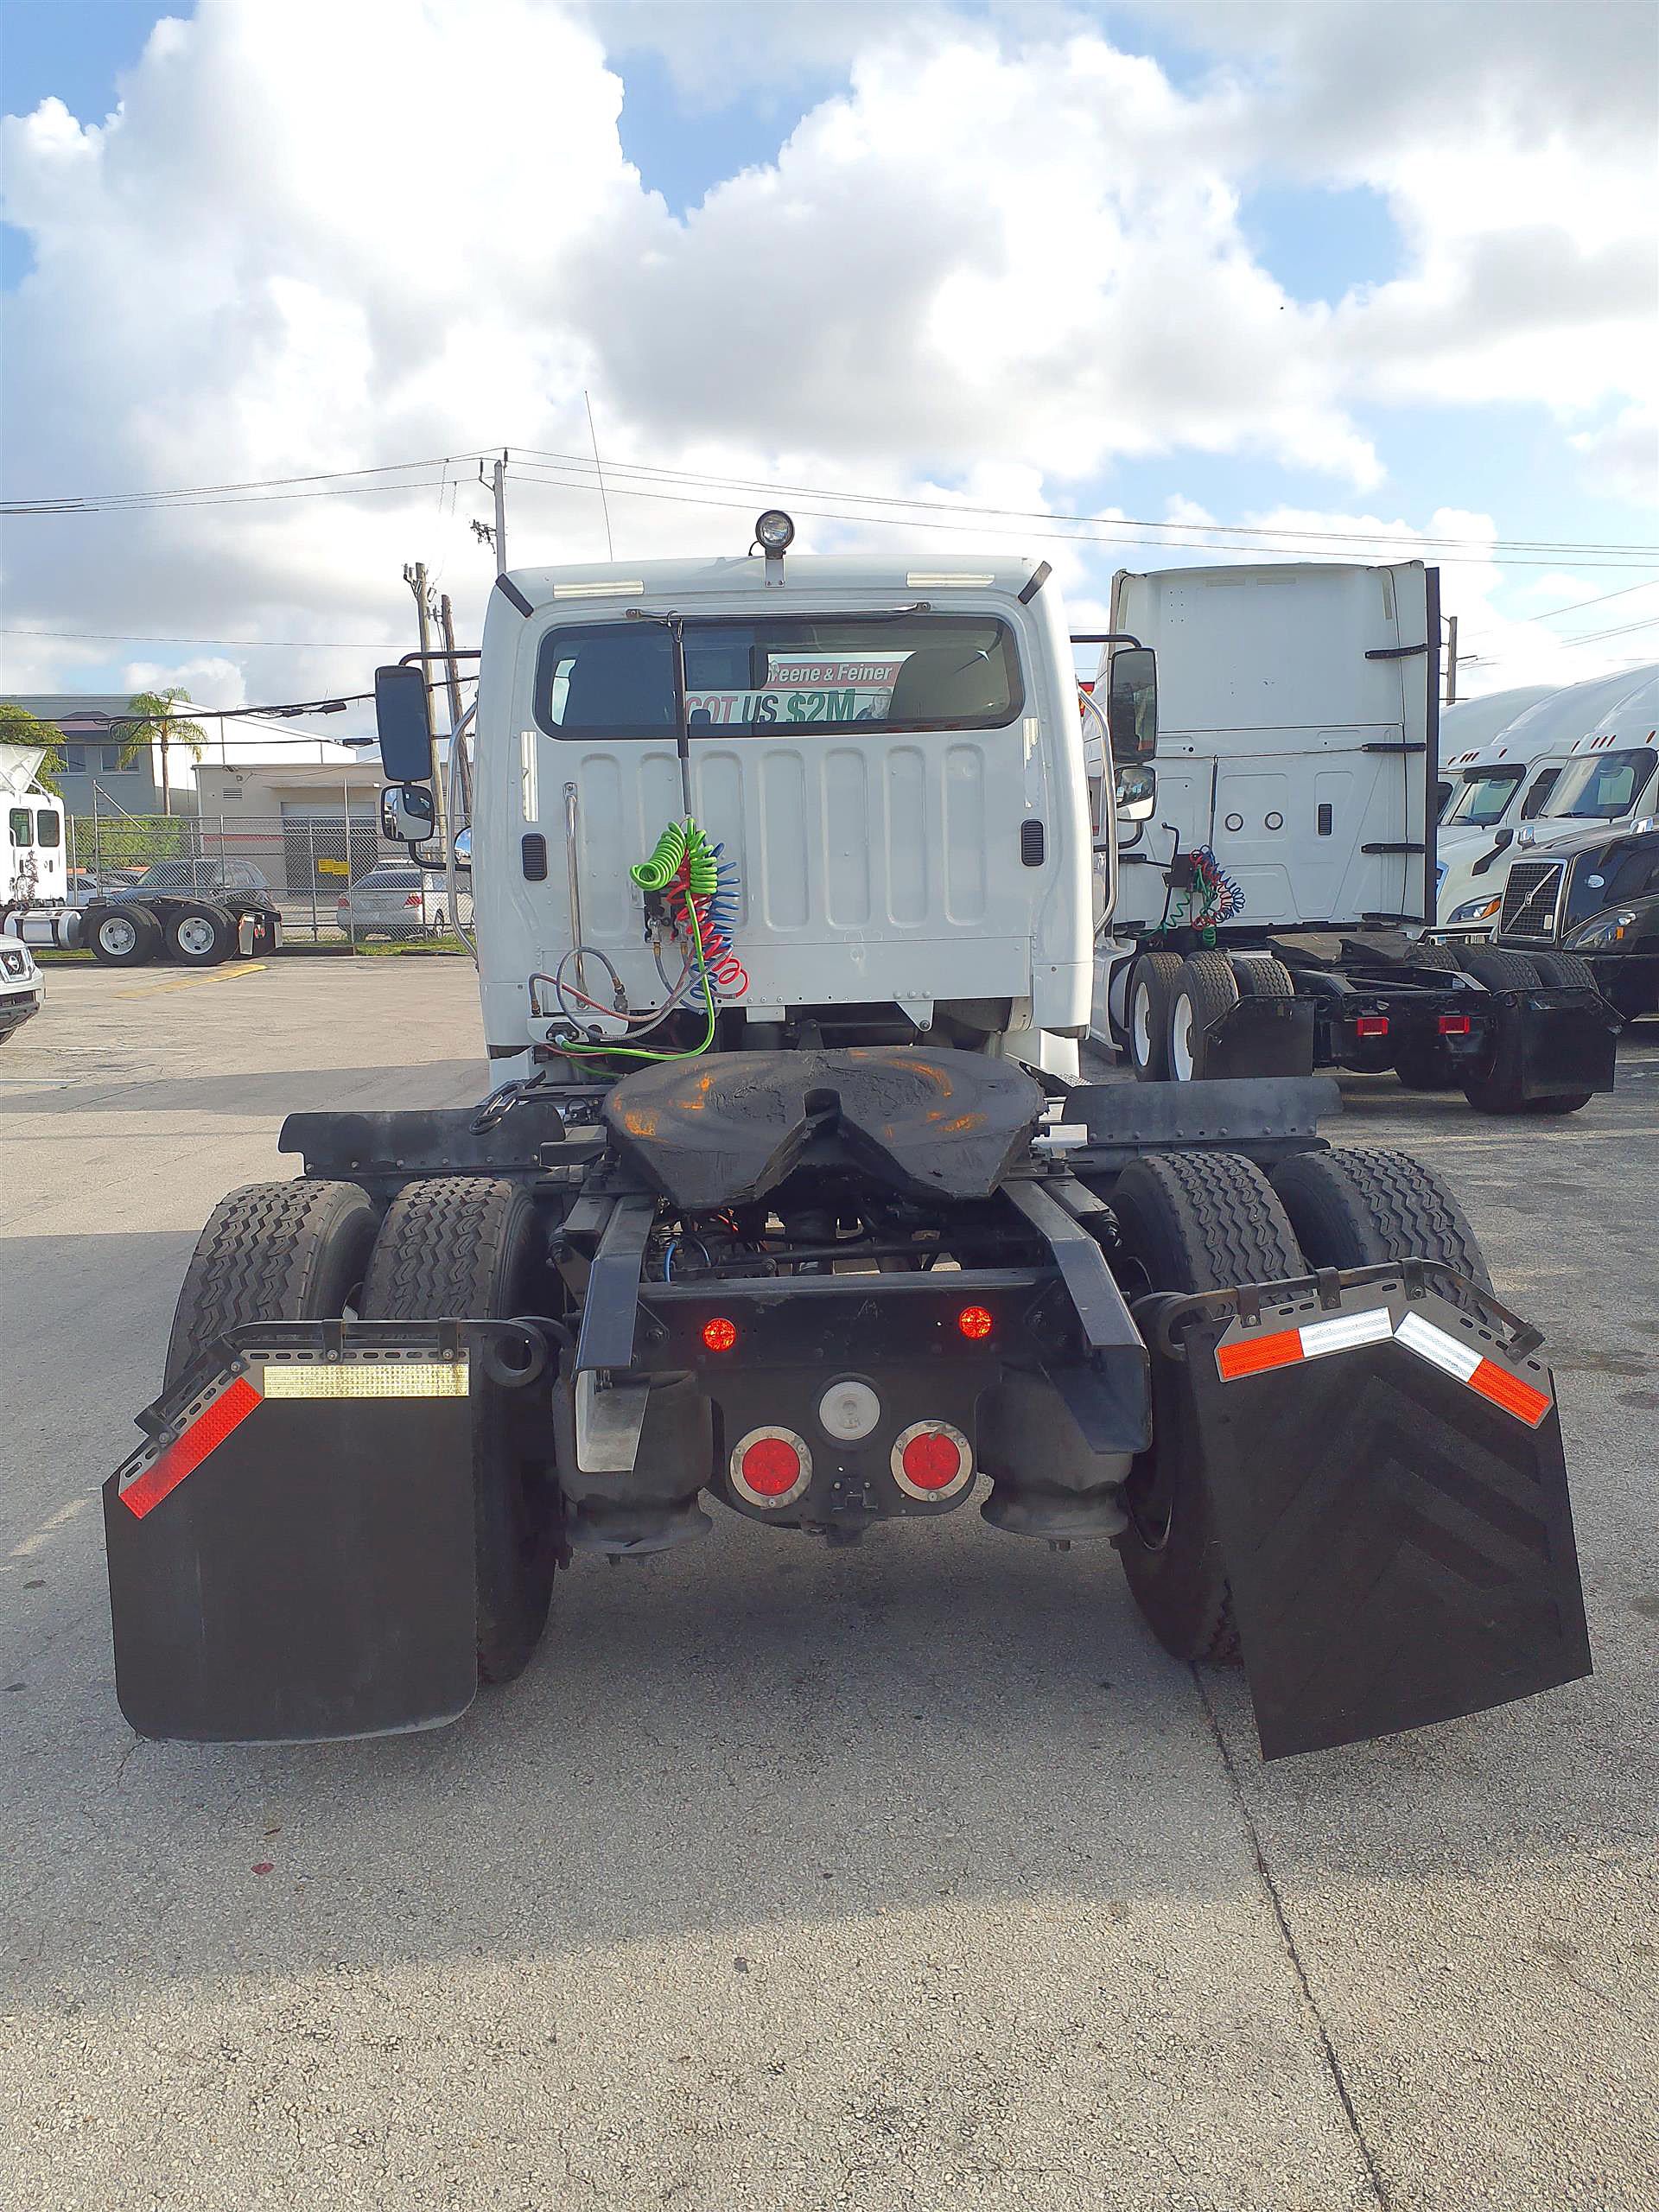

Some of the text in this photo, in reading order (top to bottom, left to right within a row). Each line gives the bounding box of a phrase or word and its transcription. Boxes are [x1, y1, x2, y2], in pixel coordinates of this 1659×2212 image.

[768, 664, 893, 683] reene & Feiner
[742, 695, 779, 724] US
[785, 688, 856, 722] $2M
